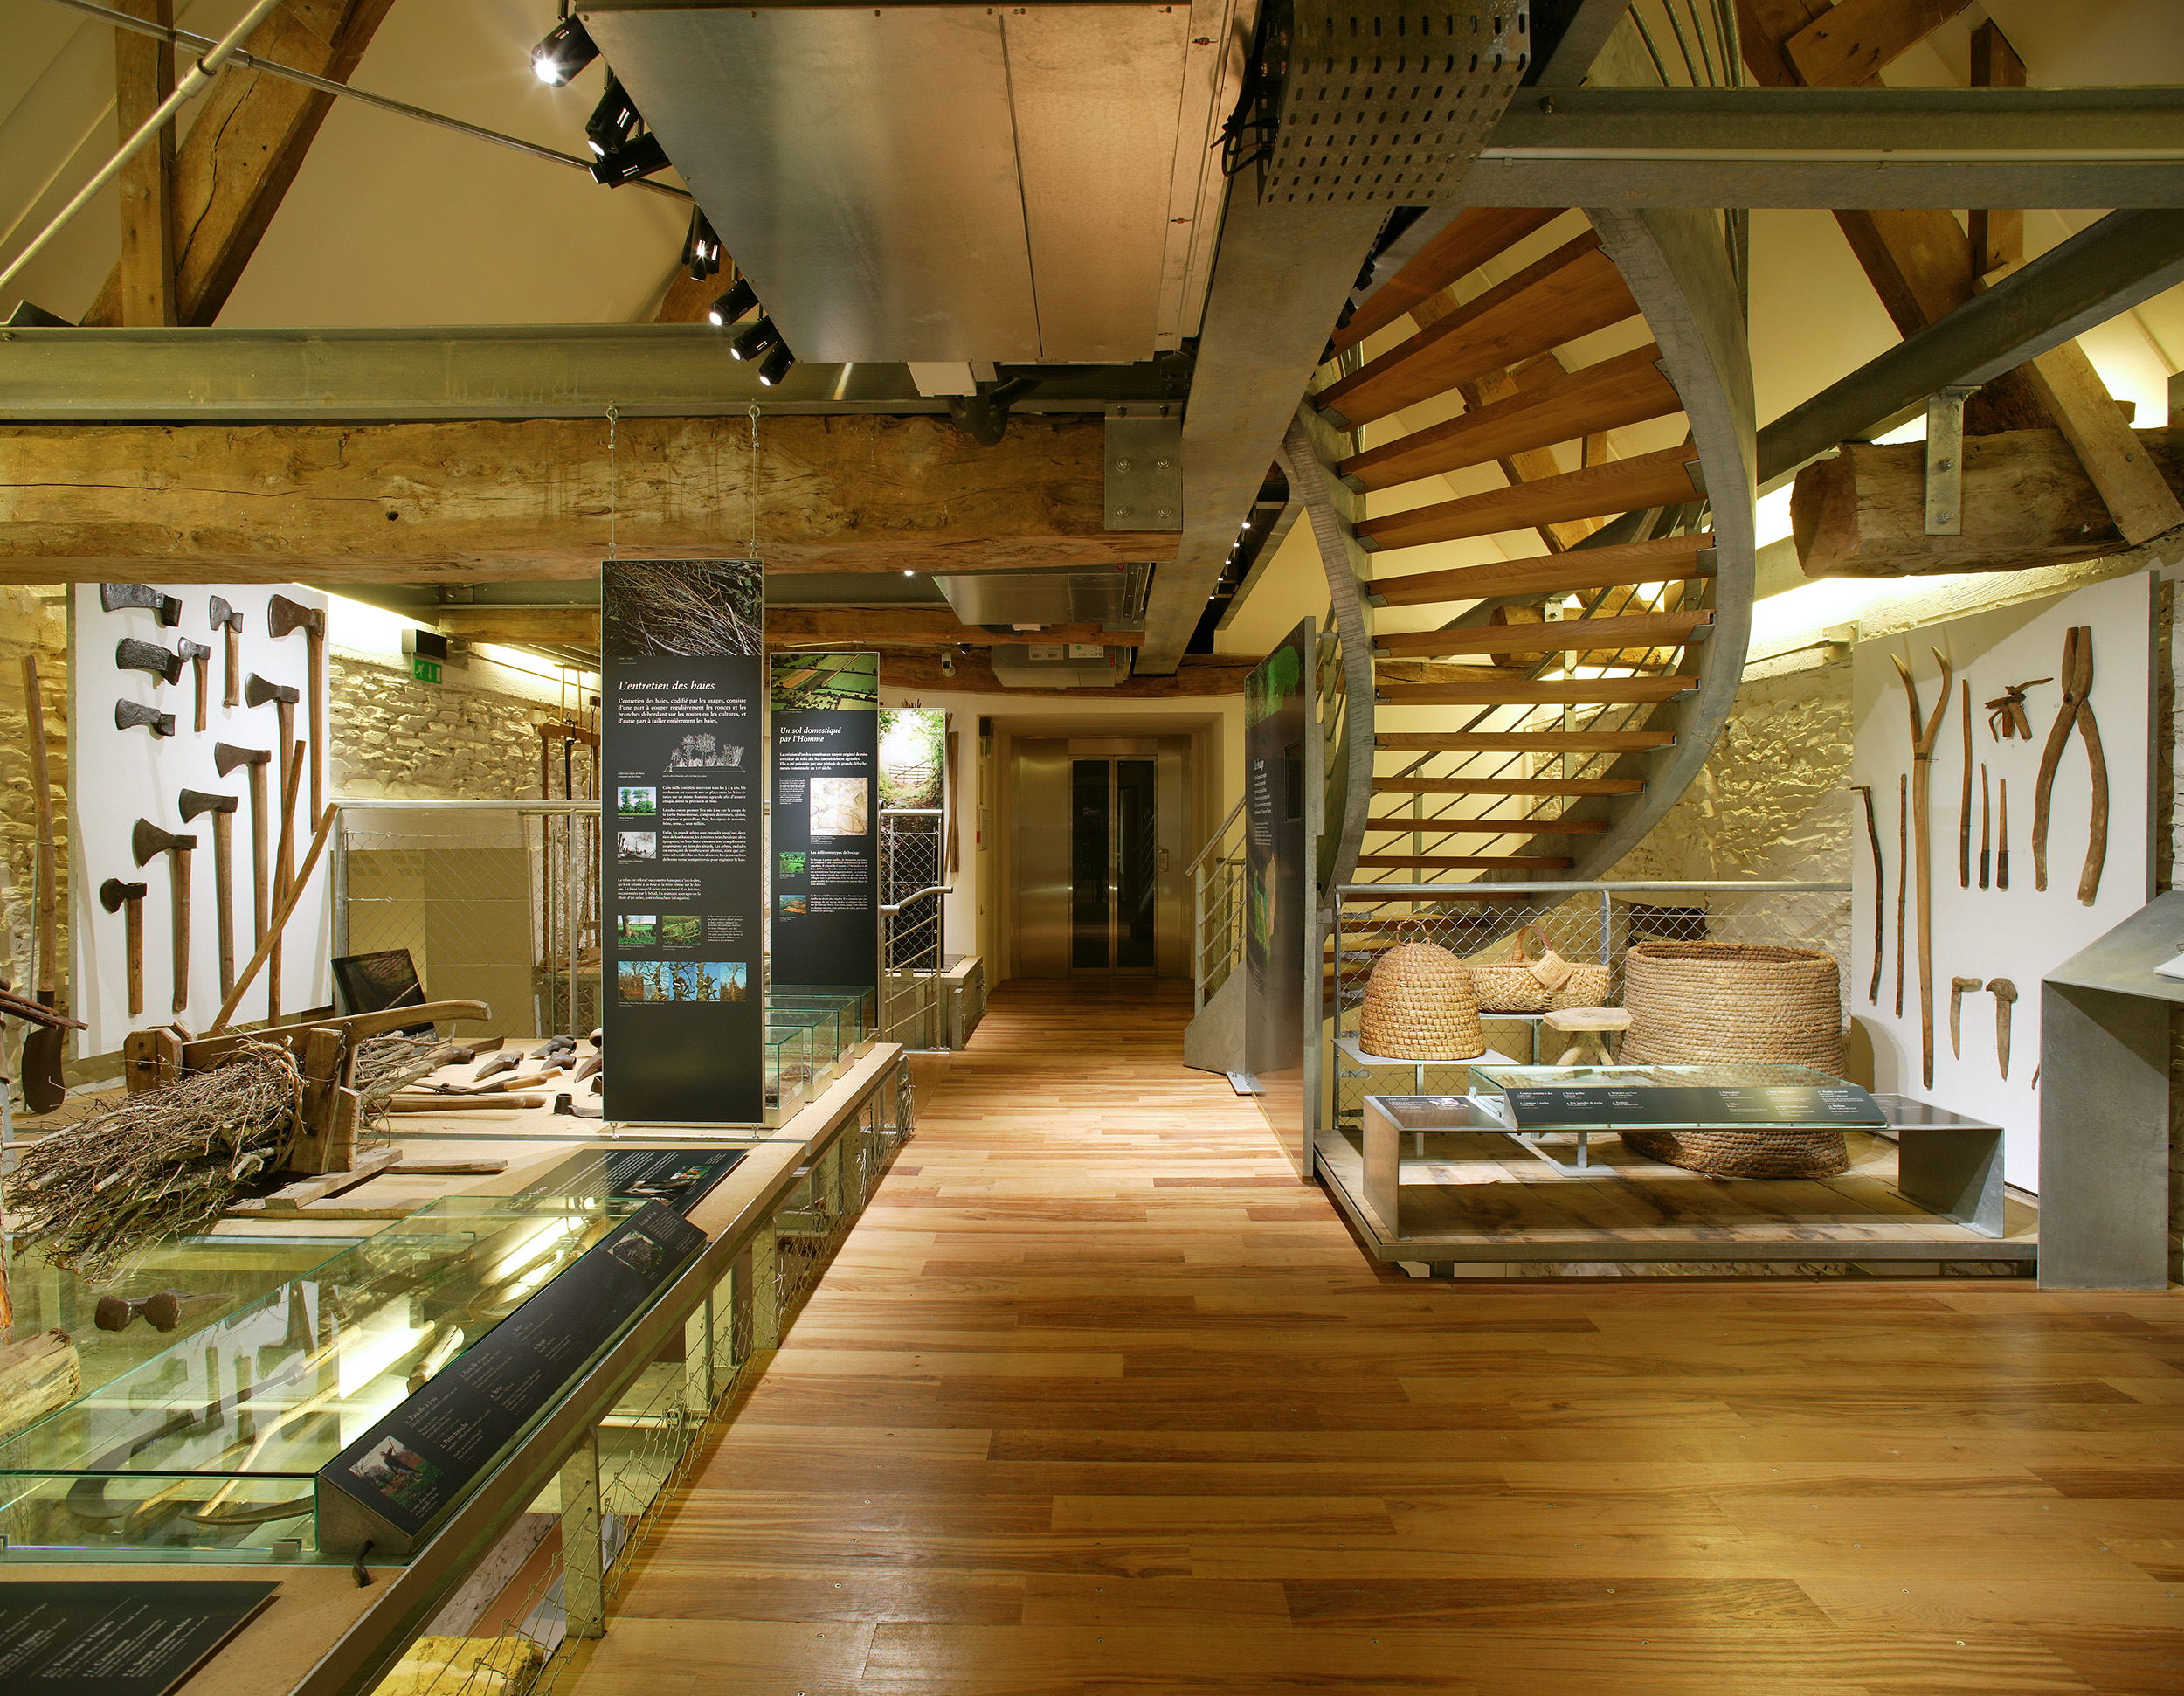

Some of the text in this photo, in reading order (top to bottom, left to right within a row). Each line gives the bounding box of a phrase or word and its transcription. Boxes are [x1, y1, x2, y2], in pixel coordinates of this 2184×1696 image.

[1116, 562, 1125, 571] CI
[619, 681, 715, 690] L'entretien des haies
